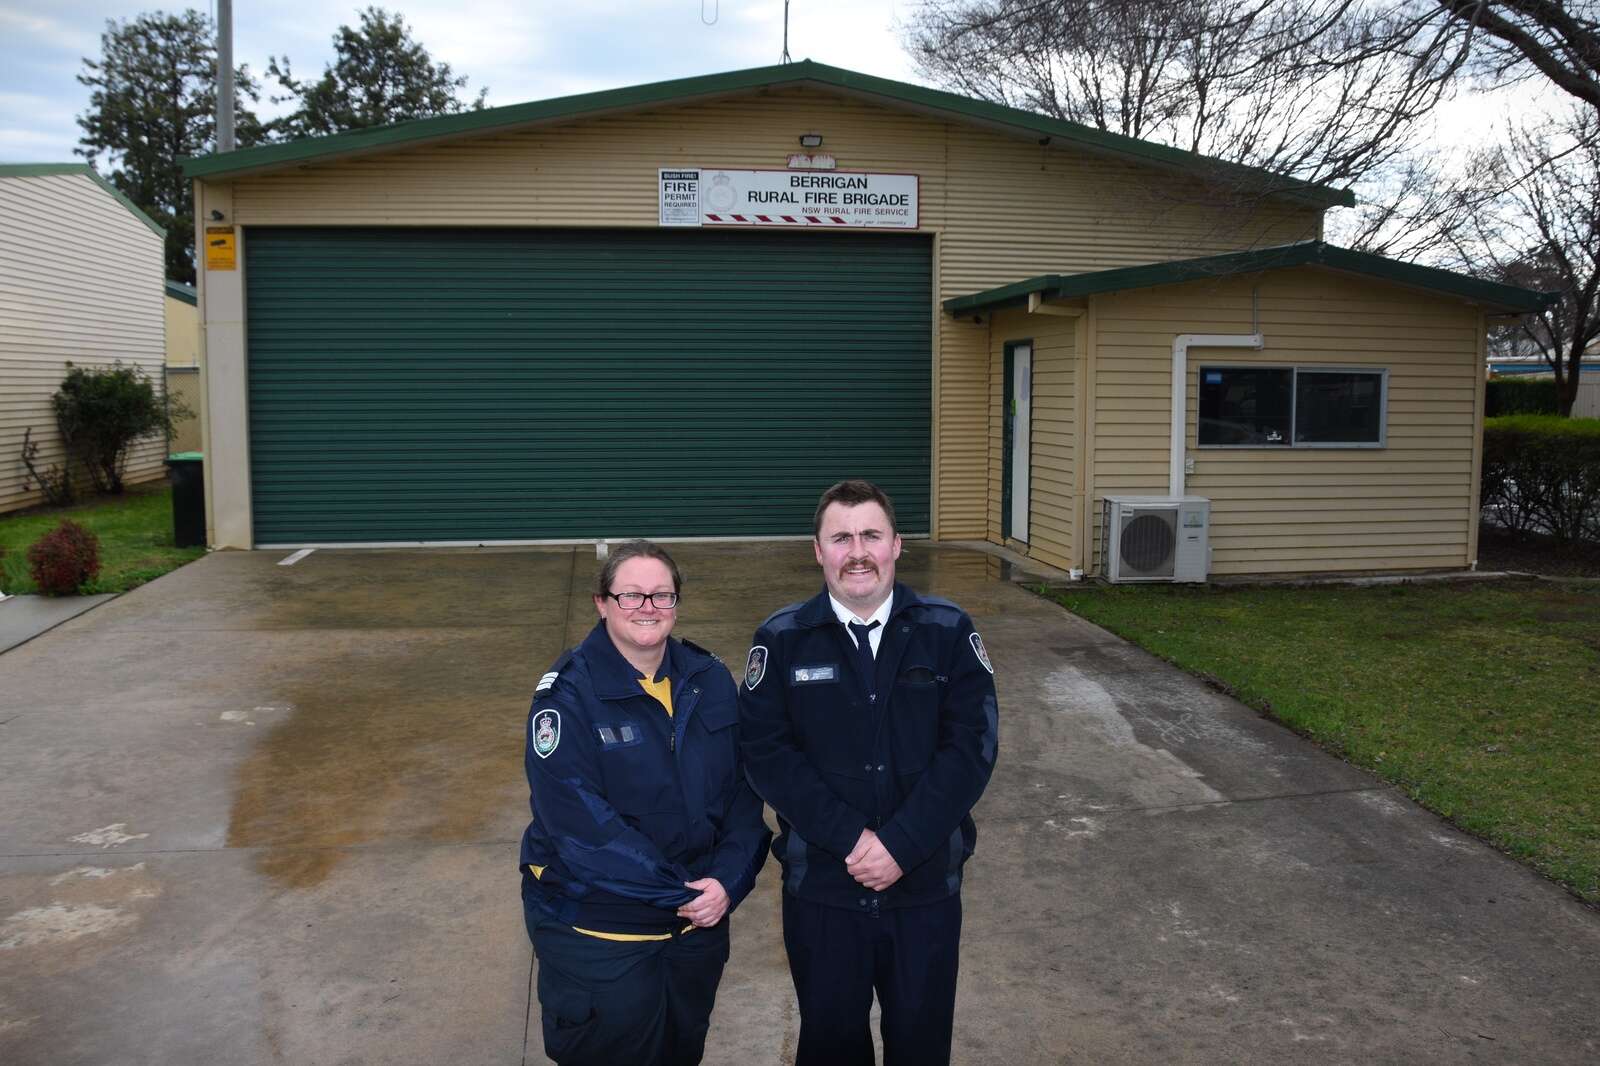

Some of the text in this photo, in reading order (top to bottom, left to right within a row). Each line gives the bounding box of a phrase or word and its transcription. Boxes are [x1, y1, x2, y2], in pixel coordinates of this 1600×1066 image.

[664, 182, 697, 192] FIRE
[790, 175, 868, 189] BERRIGAN
[664, 193, 697, 201] PERMIT
[748, 190, 909, 206] RURAL FIRE BRIGADE
[824, 207, 850, 215] RURAL
[875, 208, 909, 216] SERVICE
